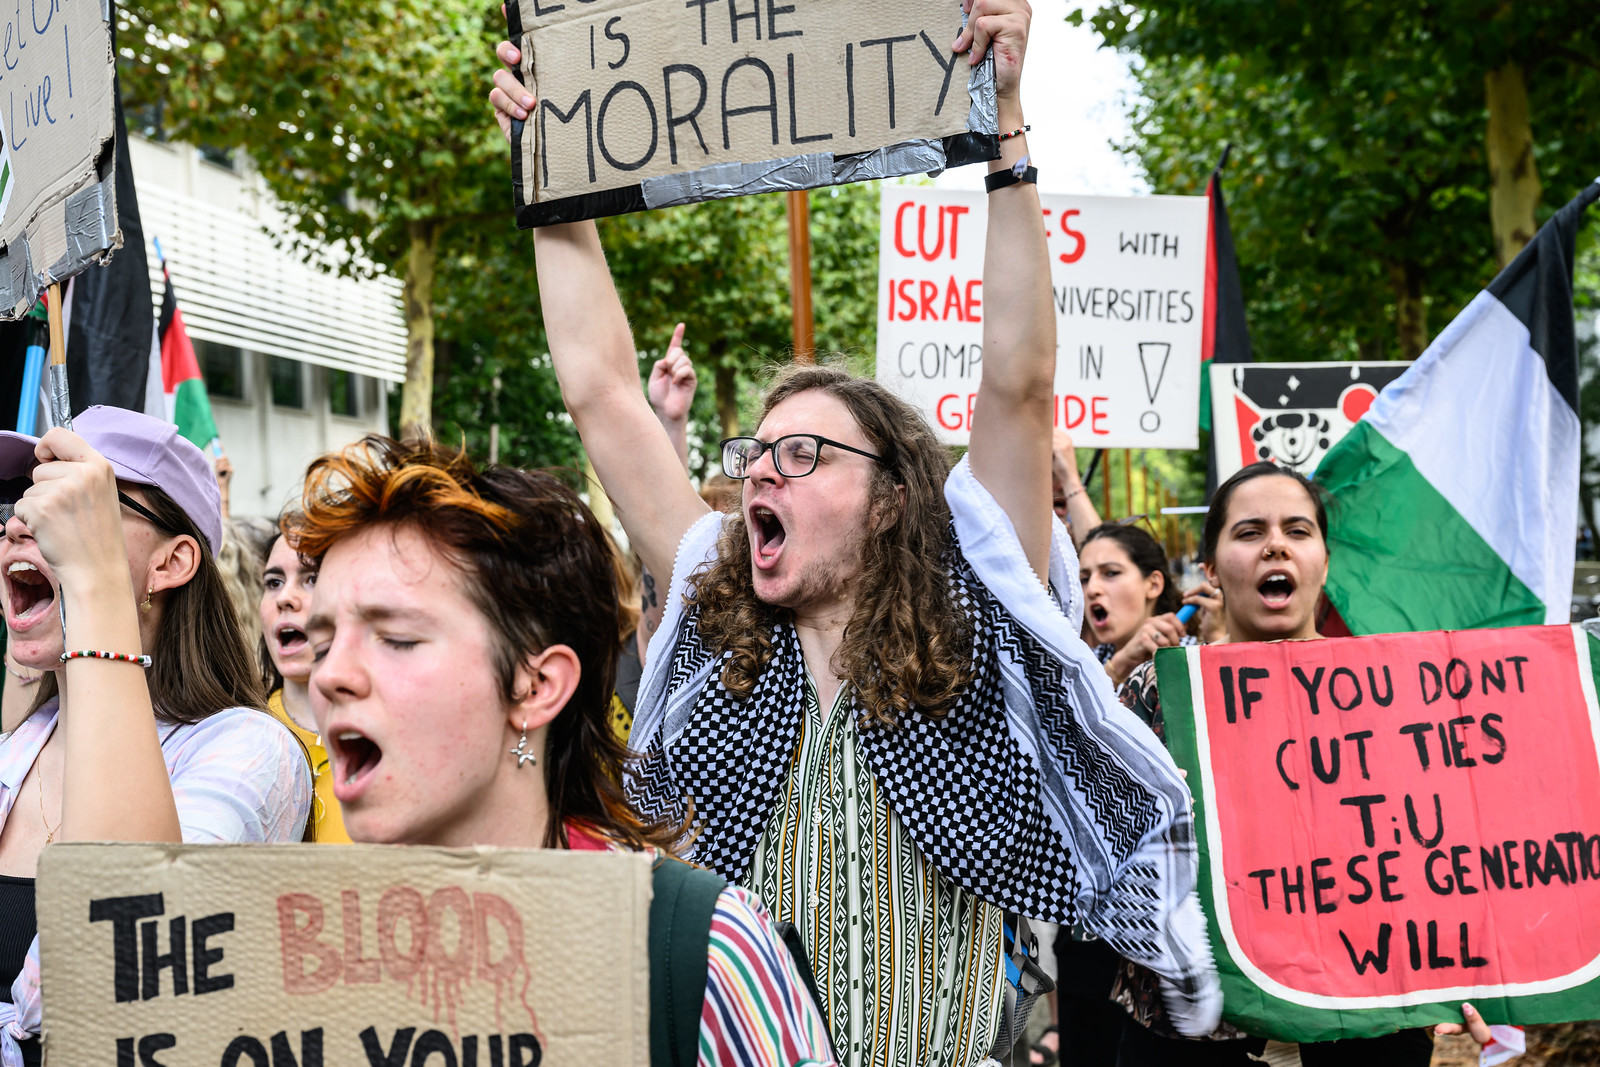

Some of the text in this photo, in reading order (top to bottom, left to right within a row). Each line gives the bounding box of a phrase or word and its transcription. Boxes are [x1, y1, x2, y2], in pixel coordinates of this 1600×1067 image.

[590, 16, 630, 70] IS
[540, 27, 964, 188] MORALITY
[894, 200, 970, 262] CUT
[1119, 231, 1179, 259] WITH
[1052, 286, 1194, 324] NIVERSITIES
[1079, 344, 1103, 380] IN
[1219, 655, 1530, 724] IF YOU DONT
[1275, 712, 1507, 791] CUT TIES
[1247, 850, 1405, 916] THESE
[88, 885, 530, 1005] THE BLOOD
[1338, 919, 1489, 976] WILL
